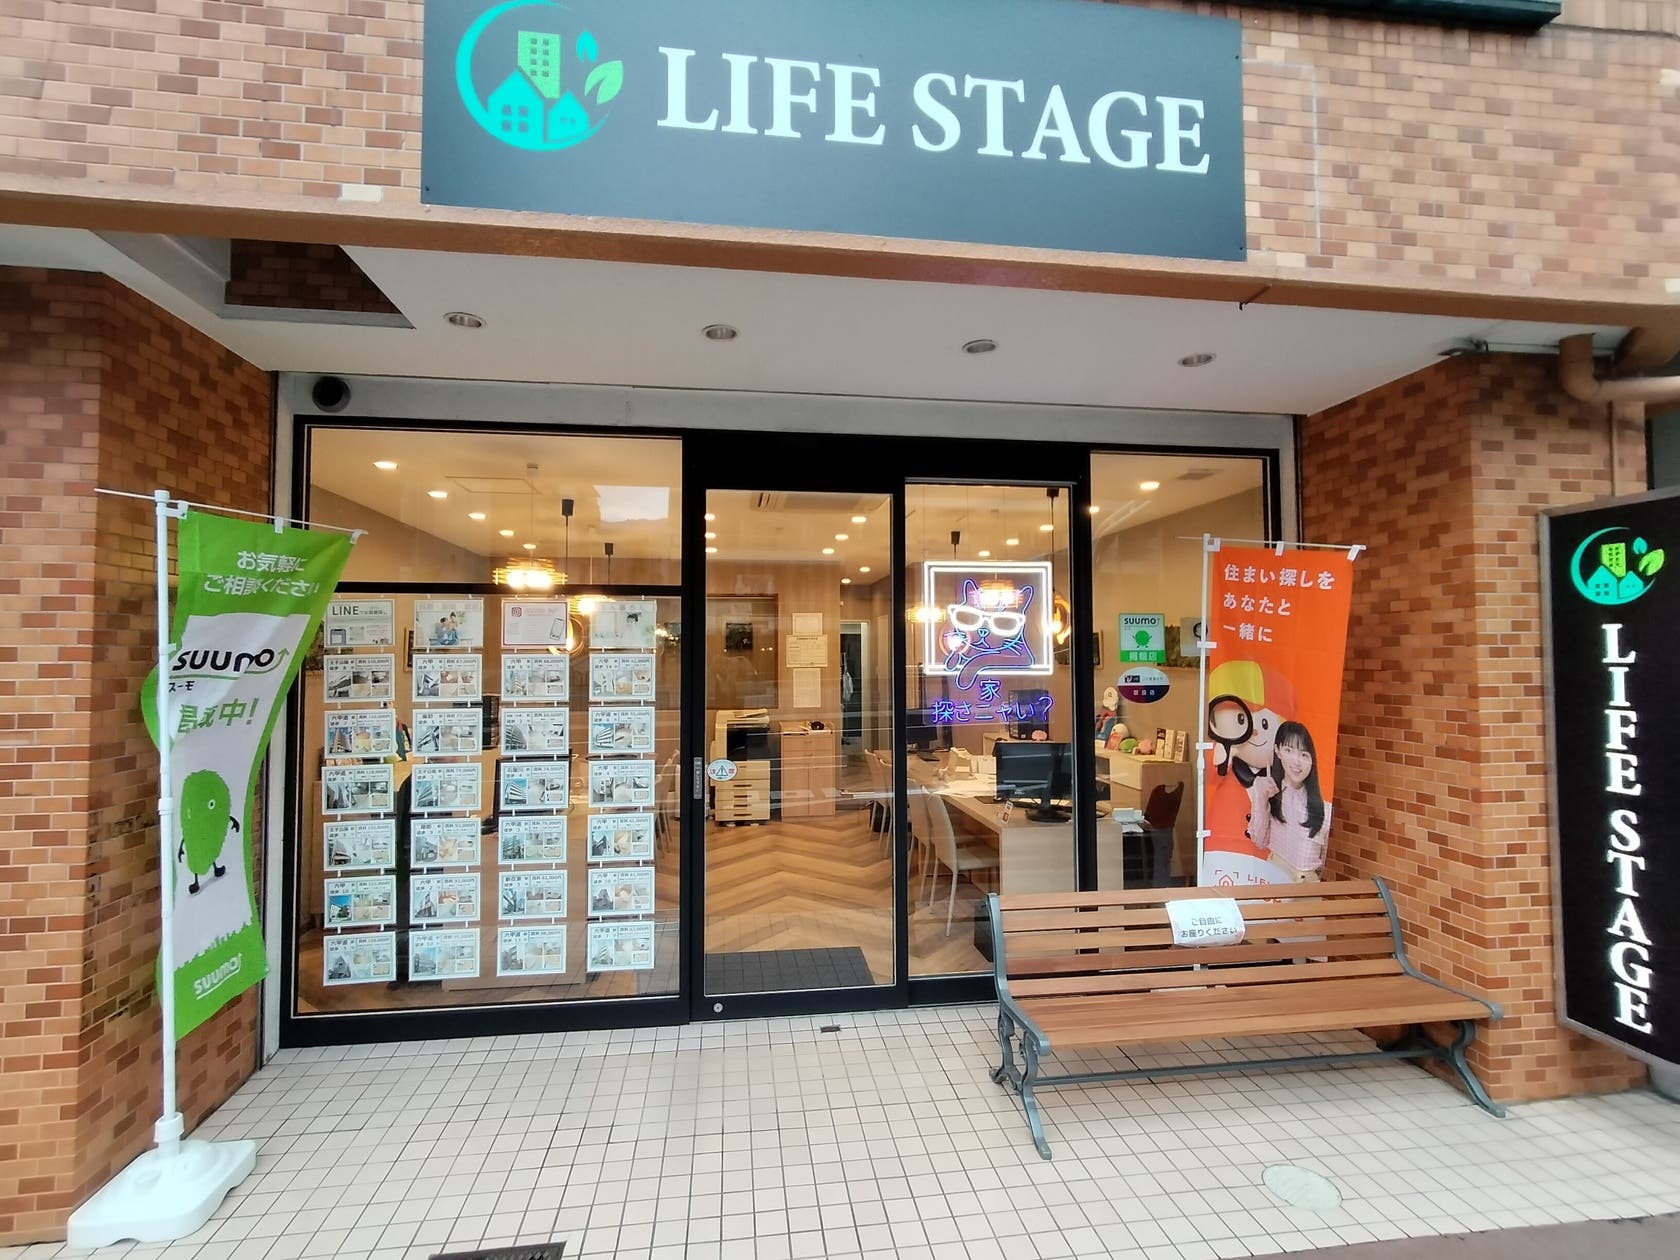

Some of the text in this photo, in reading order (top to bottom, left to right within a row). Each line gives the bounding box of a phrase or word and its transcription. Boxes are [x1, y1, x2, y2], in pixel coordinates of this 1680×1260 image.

[656, 46, 1210, 176] LIFE STAGE
[237, 550, 309, 573] お気軽に
[1224, 563, 1335, 590] 住まい探しを
[332, 605, 360, 616] LINE
[1223, 592, 1292, 616] あなたと
[1222, 622, 1273, 643] 一緒に
[979, 679, 1002, 701] 家
[1601, 622, 1655, 1036] LIFE STAGE
[1191, 916, 1223, 926] ご自由に
[1180, 927, 1238, 938] お座りください
